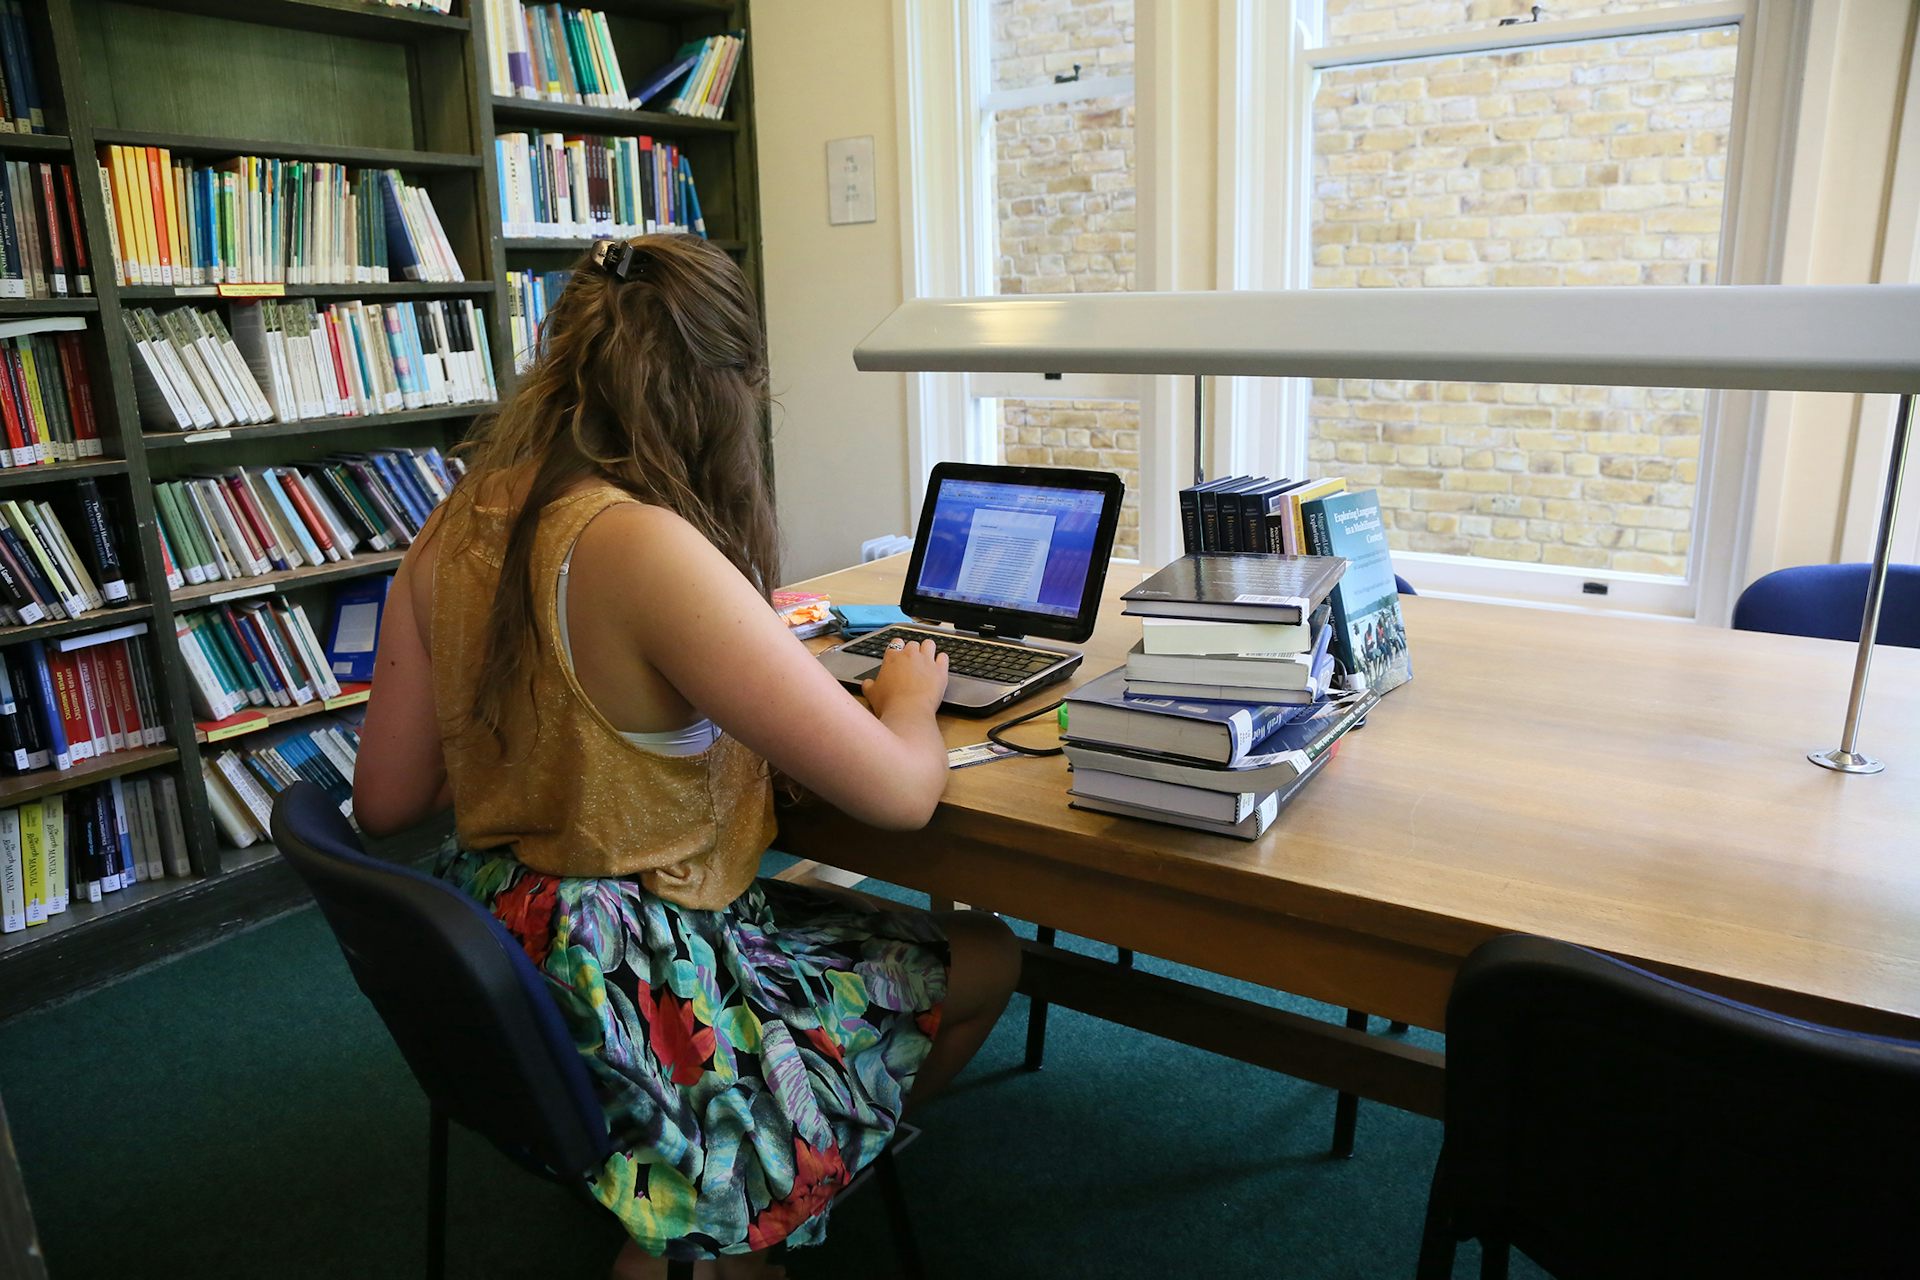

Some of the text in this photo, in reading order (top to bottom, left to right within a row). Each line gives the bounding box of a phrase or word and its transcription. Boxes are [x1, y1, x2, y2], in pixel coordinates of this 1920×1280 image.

[95, 513, 106, 532] Oxford
[1309, 514, 1319, 543] Exploring
[1334, 506, 1378, 524] Exploring Language
[100, 532, 113, 558] Handbook
[1366, 533, 1383, 544] Context
[56, 672, 72, 720] APPLIED LINGUISTICS
[66, 668, 82, 720] APPLIED LINGUISTICS
[81, 663, 96, 710] APPLIED LINGUISTICS
[101, 680, 112, 708] LINGUISTICS
[115, 660, 131, 712] APPLIED LINGUISTICS
[1267, 712, 1282, 734] Arab
[26, 833, 38, 858] Research
[46, 824, 59, 848] Research
[2, 839, 16, 864] Research
[48, 850, 57, 877] MANUAL
[4, 865, 14, 894] MANUAL
[28, 858, 38, 886] MANUAL
